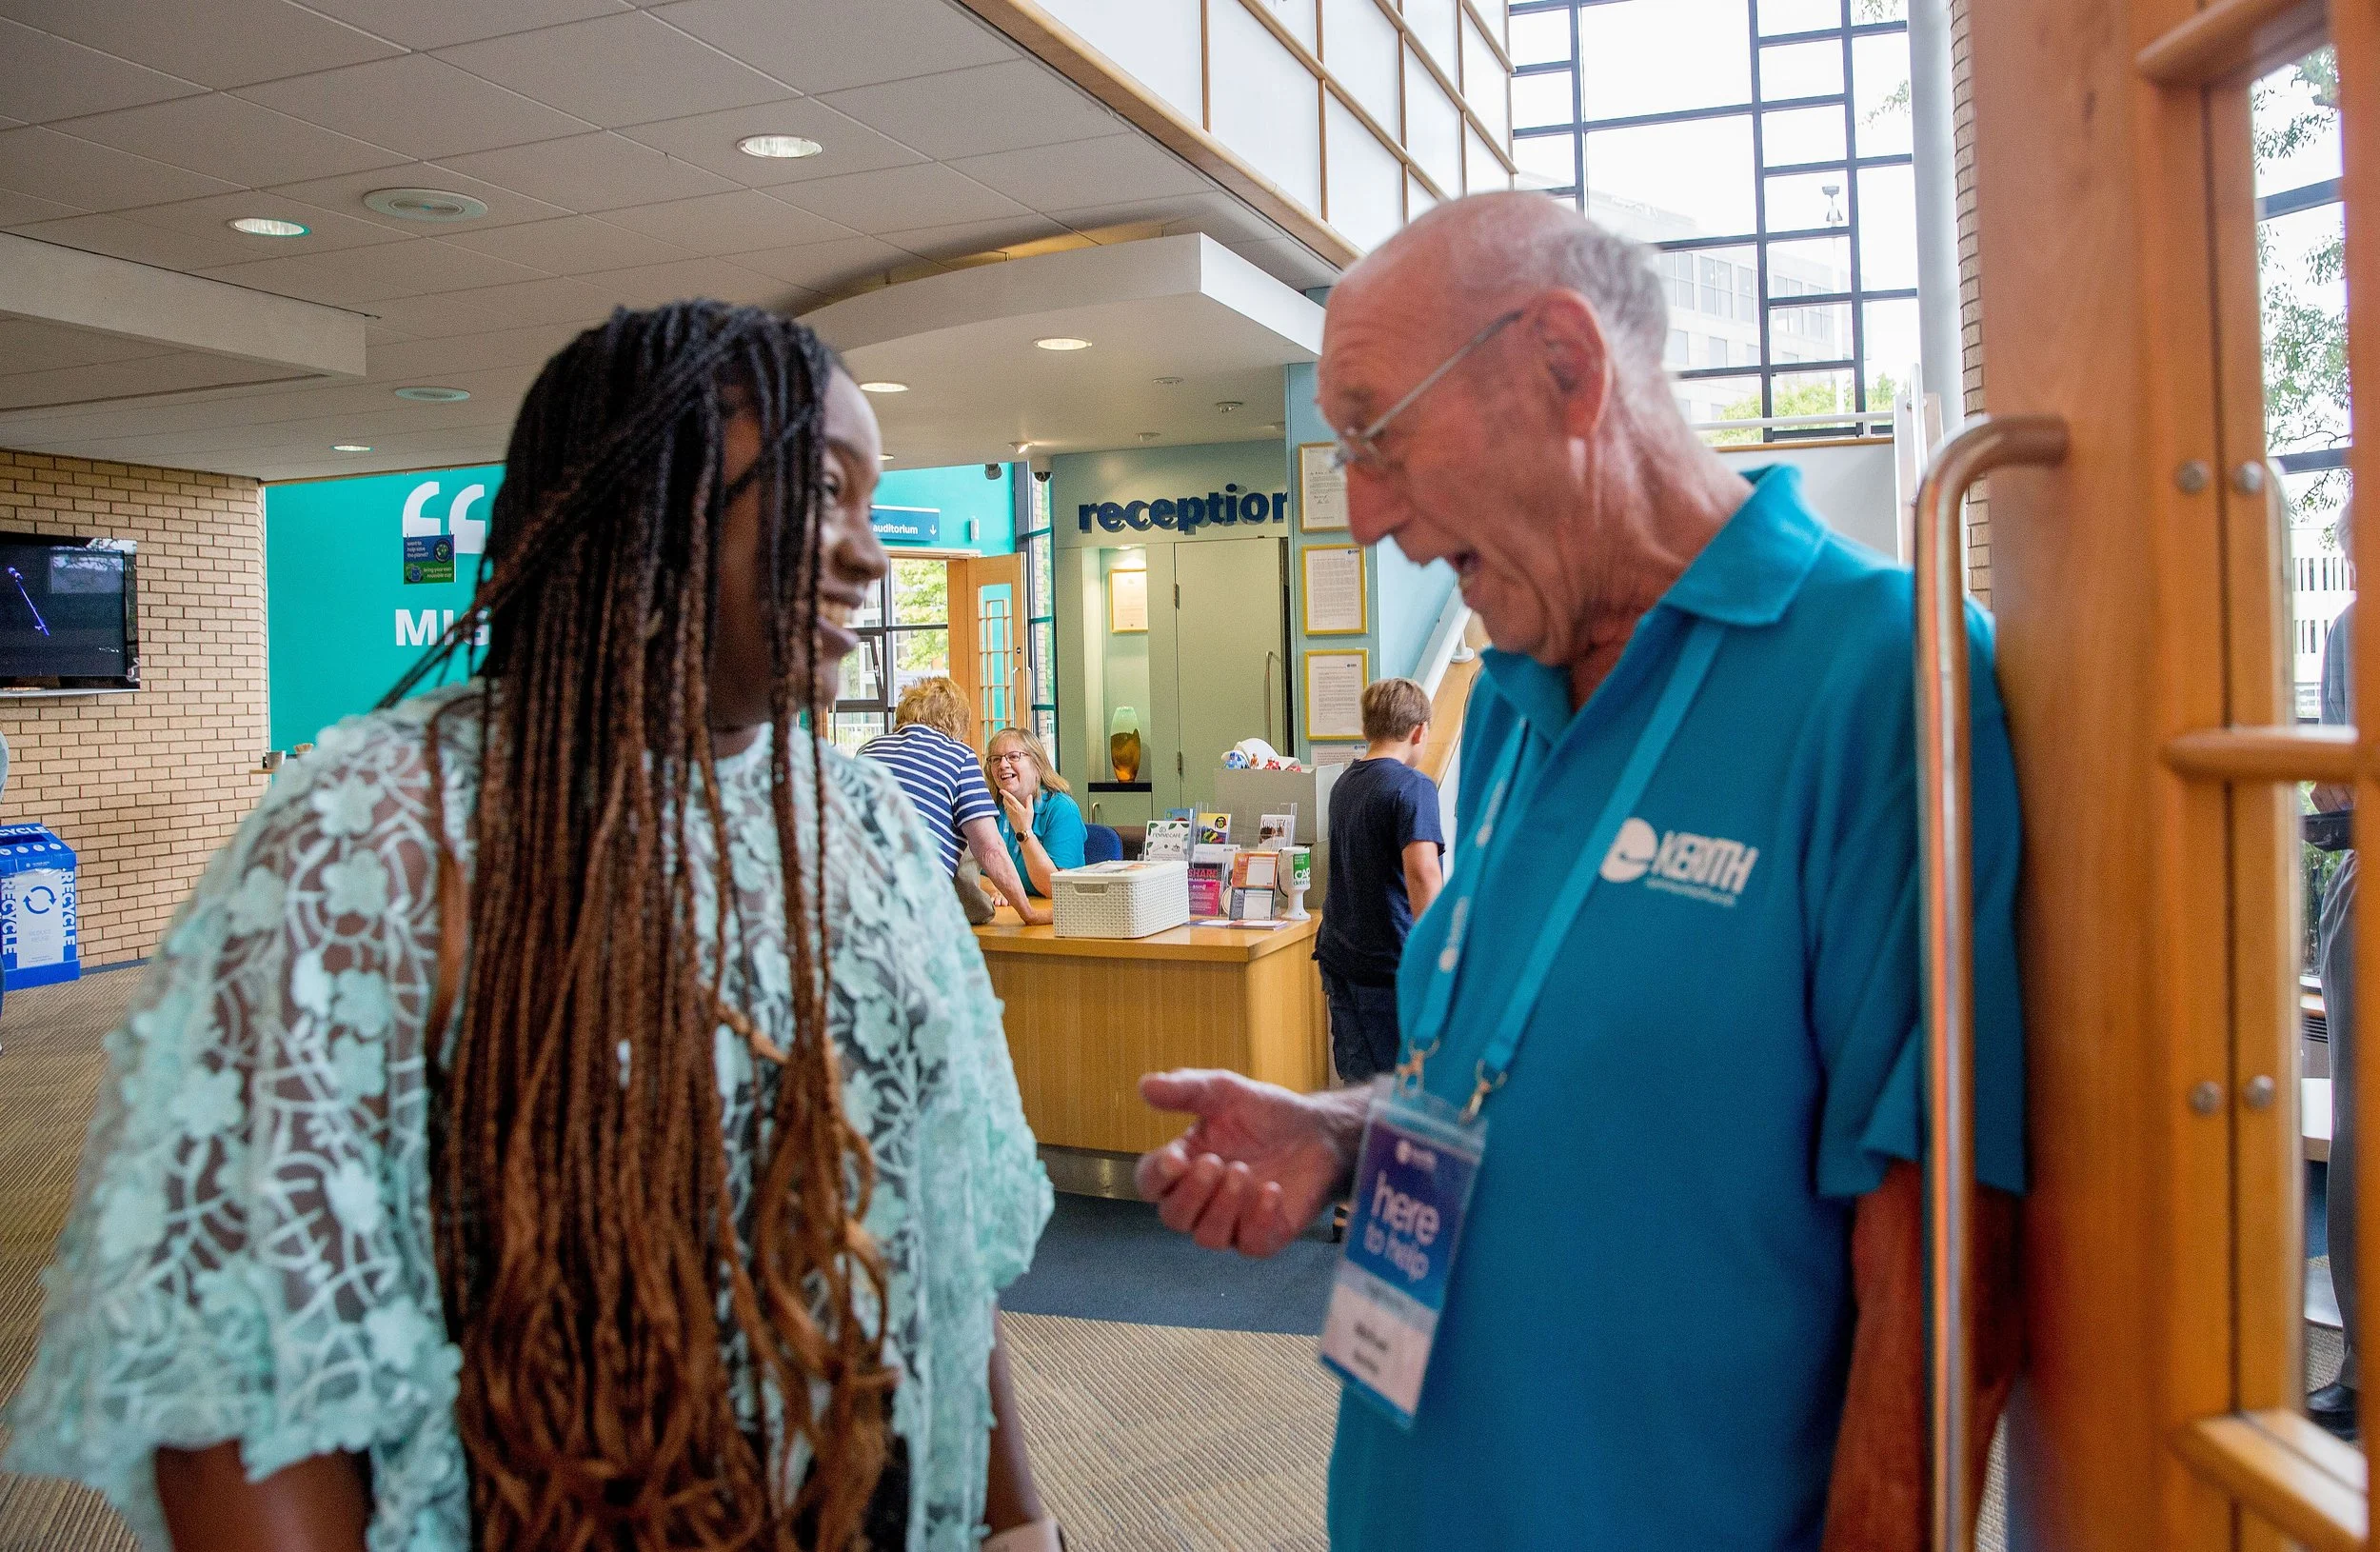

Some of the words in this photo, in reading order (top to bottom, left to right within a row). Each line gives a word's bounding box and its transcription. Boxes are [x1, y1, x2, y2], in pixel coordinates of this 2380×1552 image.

[872, 523, 919, 535] auditorium
[1188, 868, 1219, 878] SHARE
[1, 878, 18, 956] RECYCLE
[61, 870, 76, 946] RECYCLE
[1371, 1169, 1441, 1247] here
[1386, 1228, 1430, 1283] help
